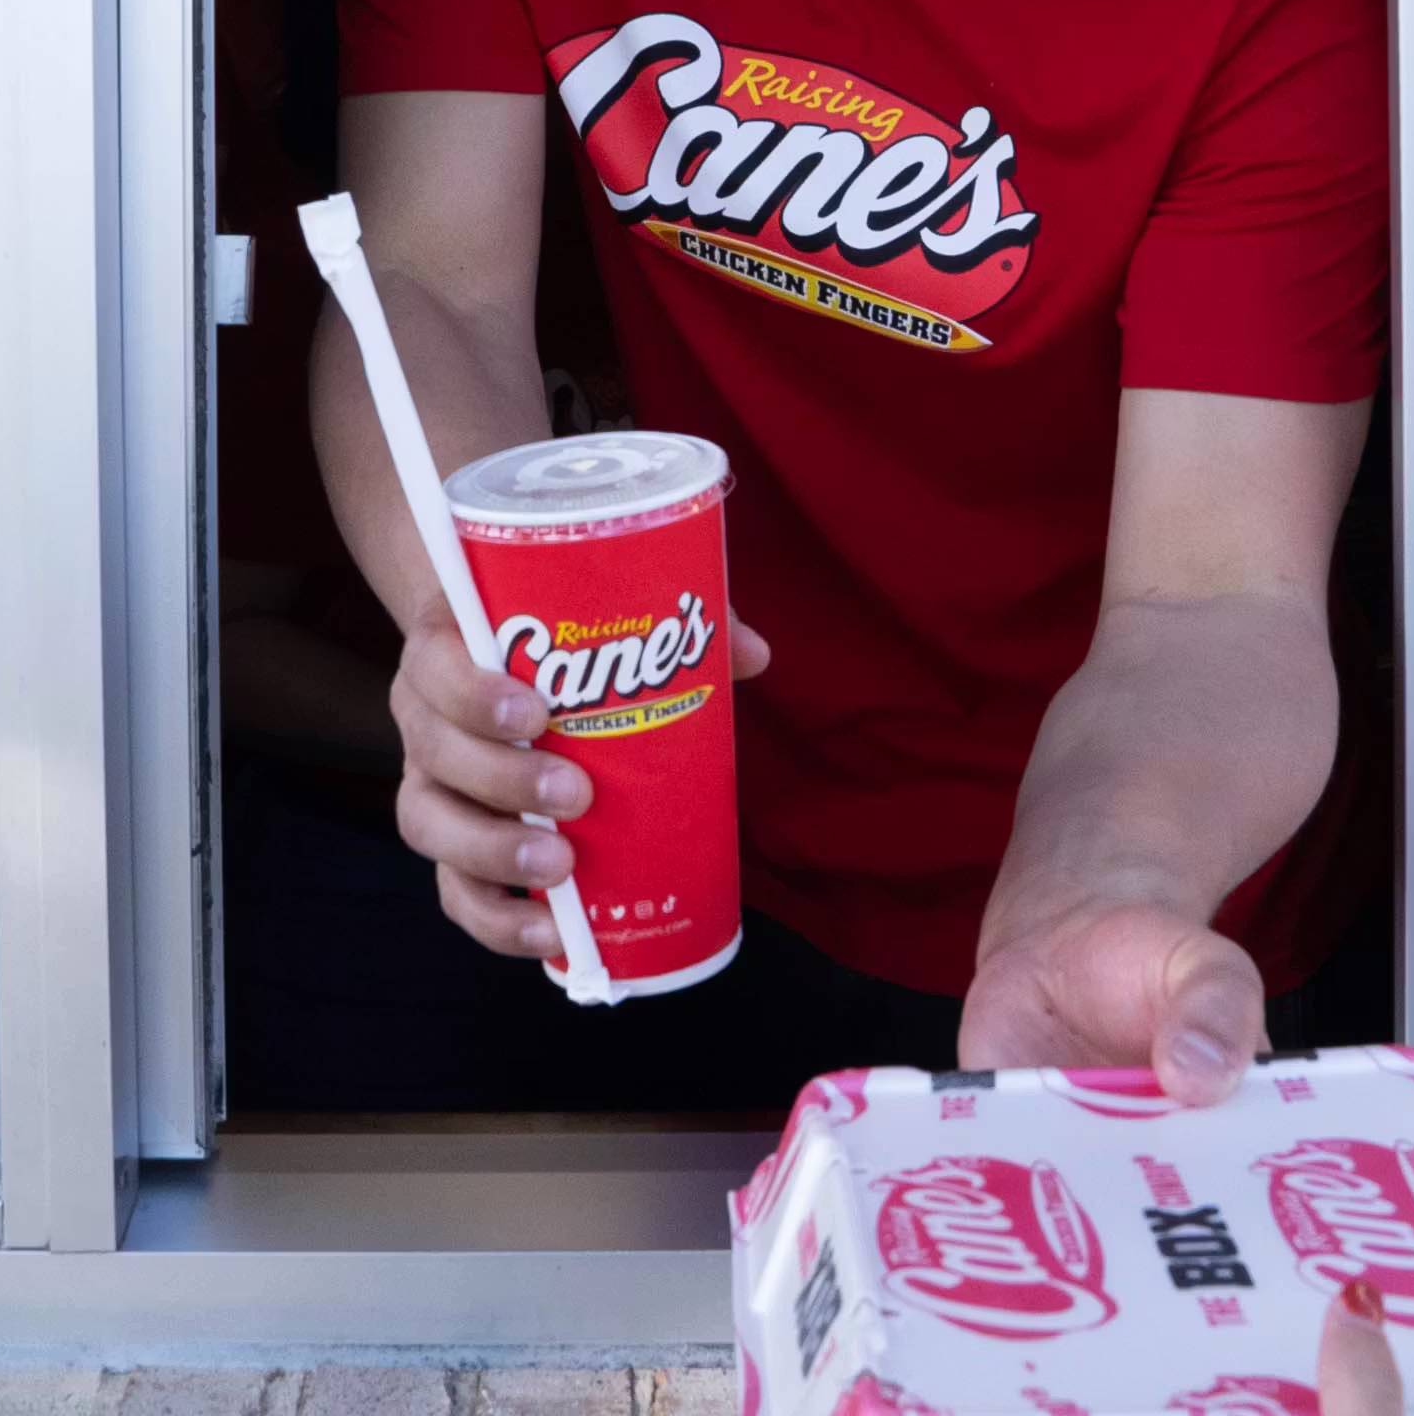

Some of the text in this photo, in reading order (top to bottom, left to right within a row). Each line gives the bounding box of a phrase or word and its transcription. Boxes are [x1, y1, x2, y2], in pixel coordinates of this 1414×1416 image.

[559, 13, 1039, 256] Cane's
[724, 58, 904, 142] Raising
[679, 230, 950, 346] CHICKEN FINGERS
[555, 614, 654, 646] Raising
[562, 692, 704, 732] CHICKEN FINGERS
[870, 1157, 1109, 1331] Cane's
[1143, 1206, 1255, 1289] BOX
[1198, 1296, 1248, 1327] THE
